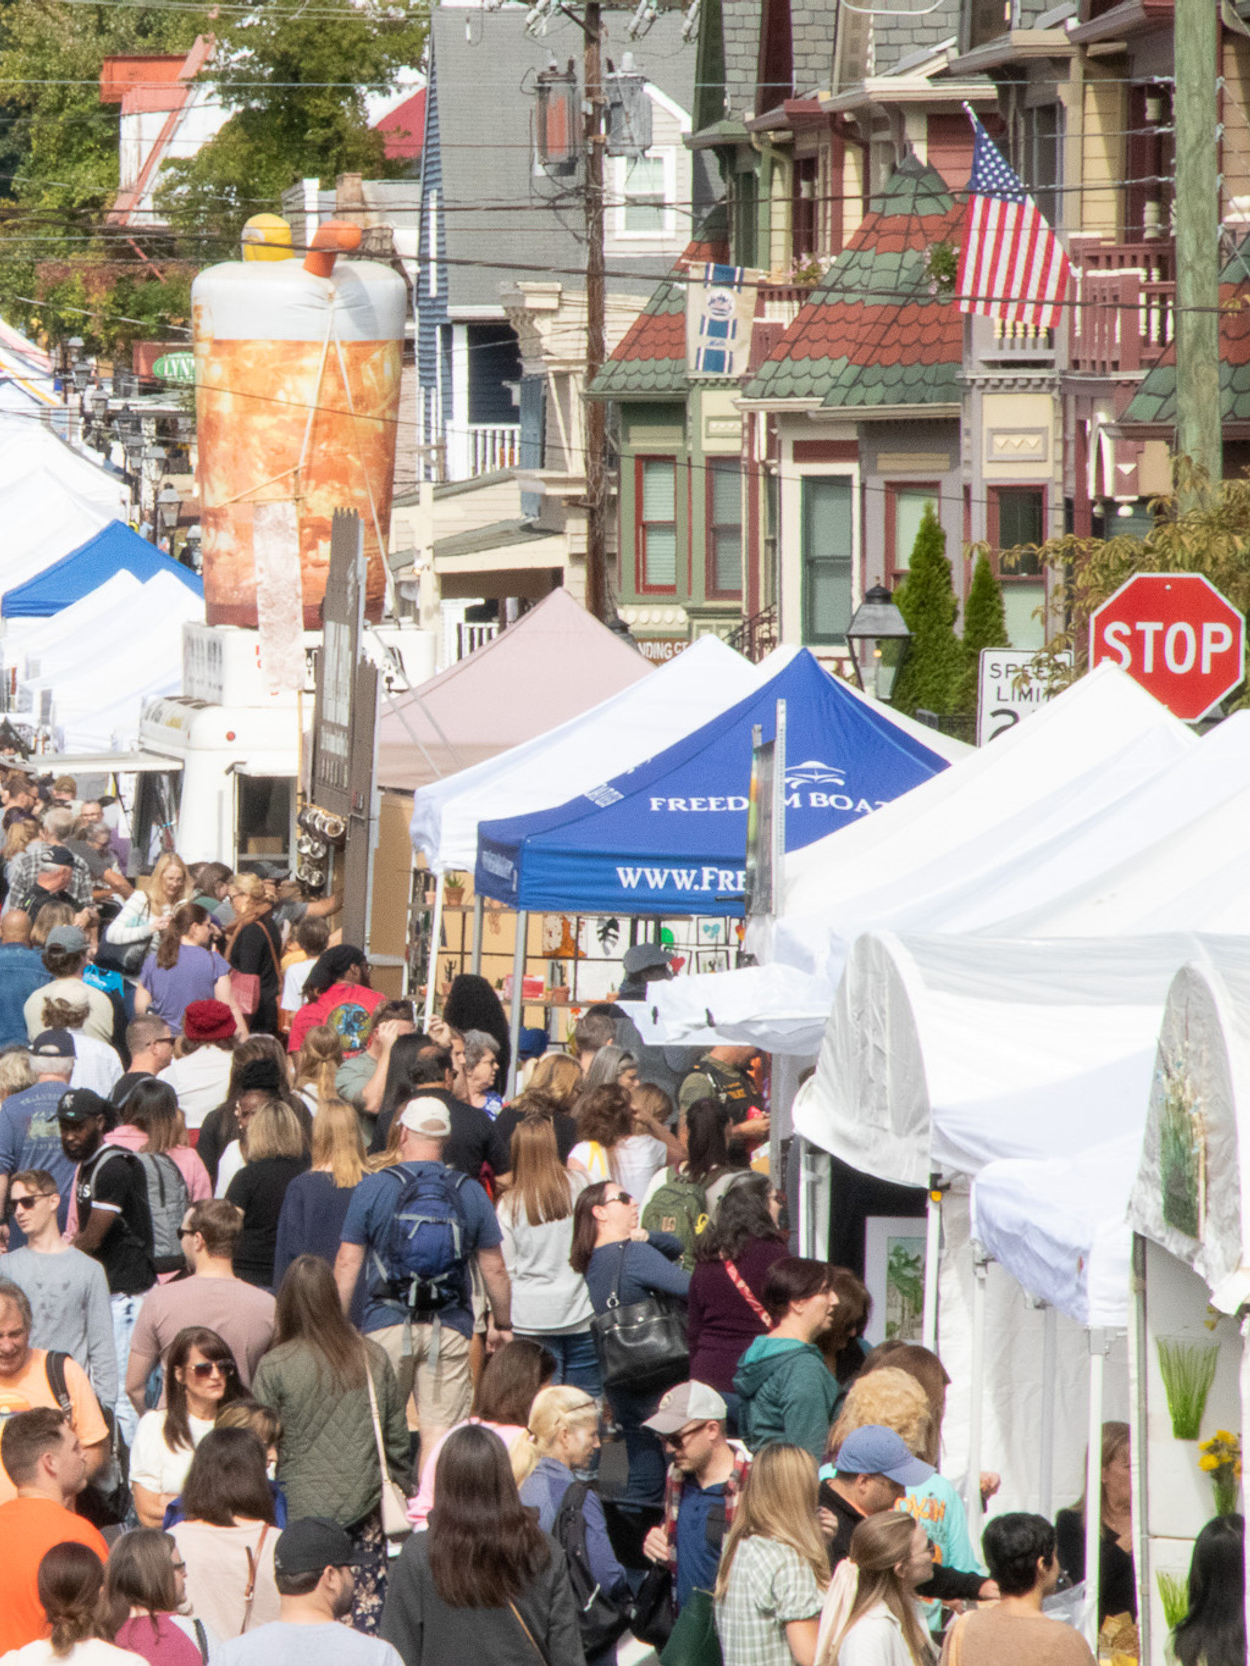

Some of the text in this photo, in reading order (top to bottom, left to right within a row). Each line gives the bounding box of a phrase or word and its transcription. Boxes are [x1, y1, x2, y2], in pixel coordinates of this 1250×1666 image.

[1101, 621, 1233, 674] STOP
[989, 662, 1059, 680] SPEE
[650, 793, 803, 812] FREEDM
